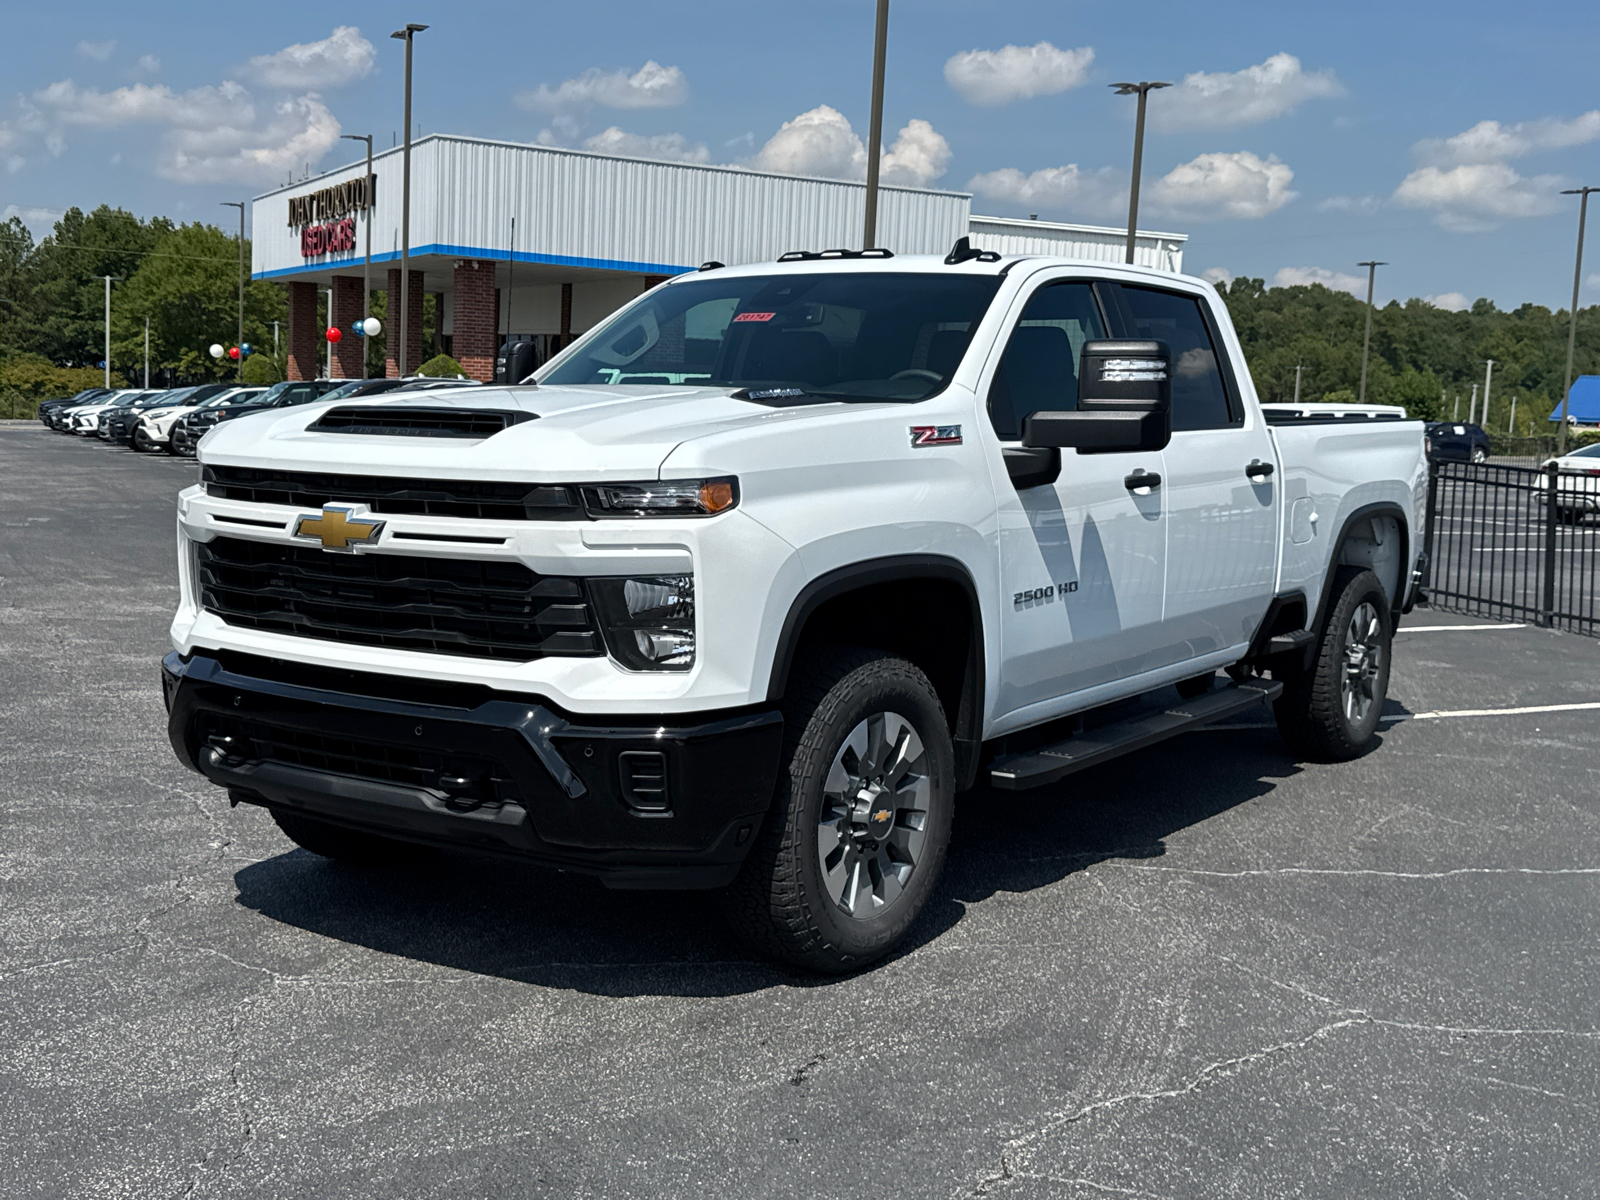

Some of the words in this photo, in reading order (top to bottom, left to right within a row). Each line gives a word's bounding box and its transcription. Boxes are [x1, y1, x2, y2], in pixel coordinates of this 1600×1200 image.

[288, 194, 314, 227] JOHN
[301, 225, 325, 257] USED
[326, 217, 354, 253] CARS
[910, 424, 963, 448] Z71
[1013, 585, 1055, 605] 2500
[1058, 580, 1079, 596] HD
